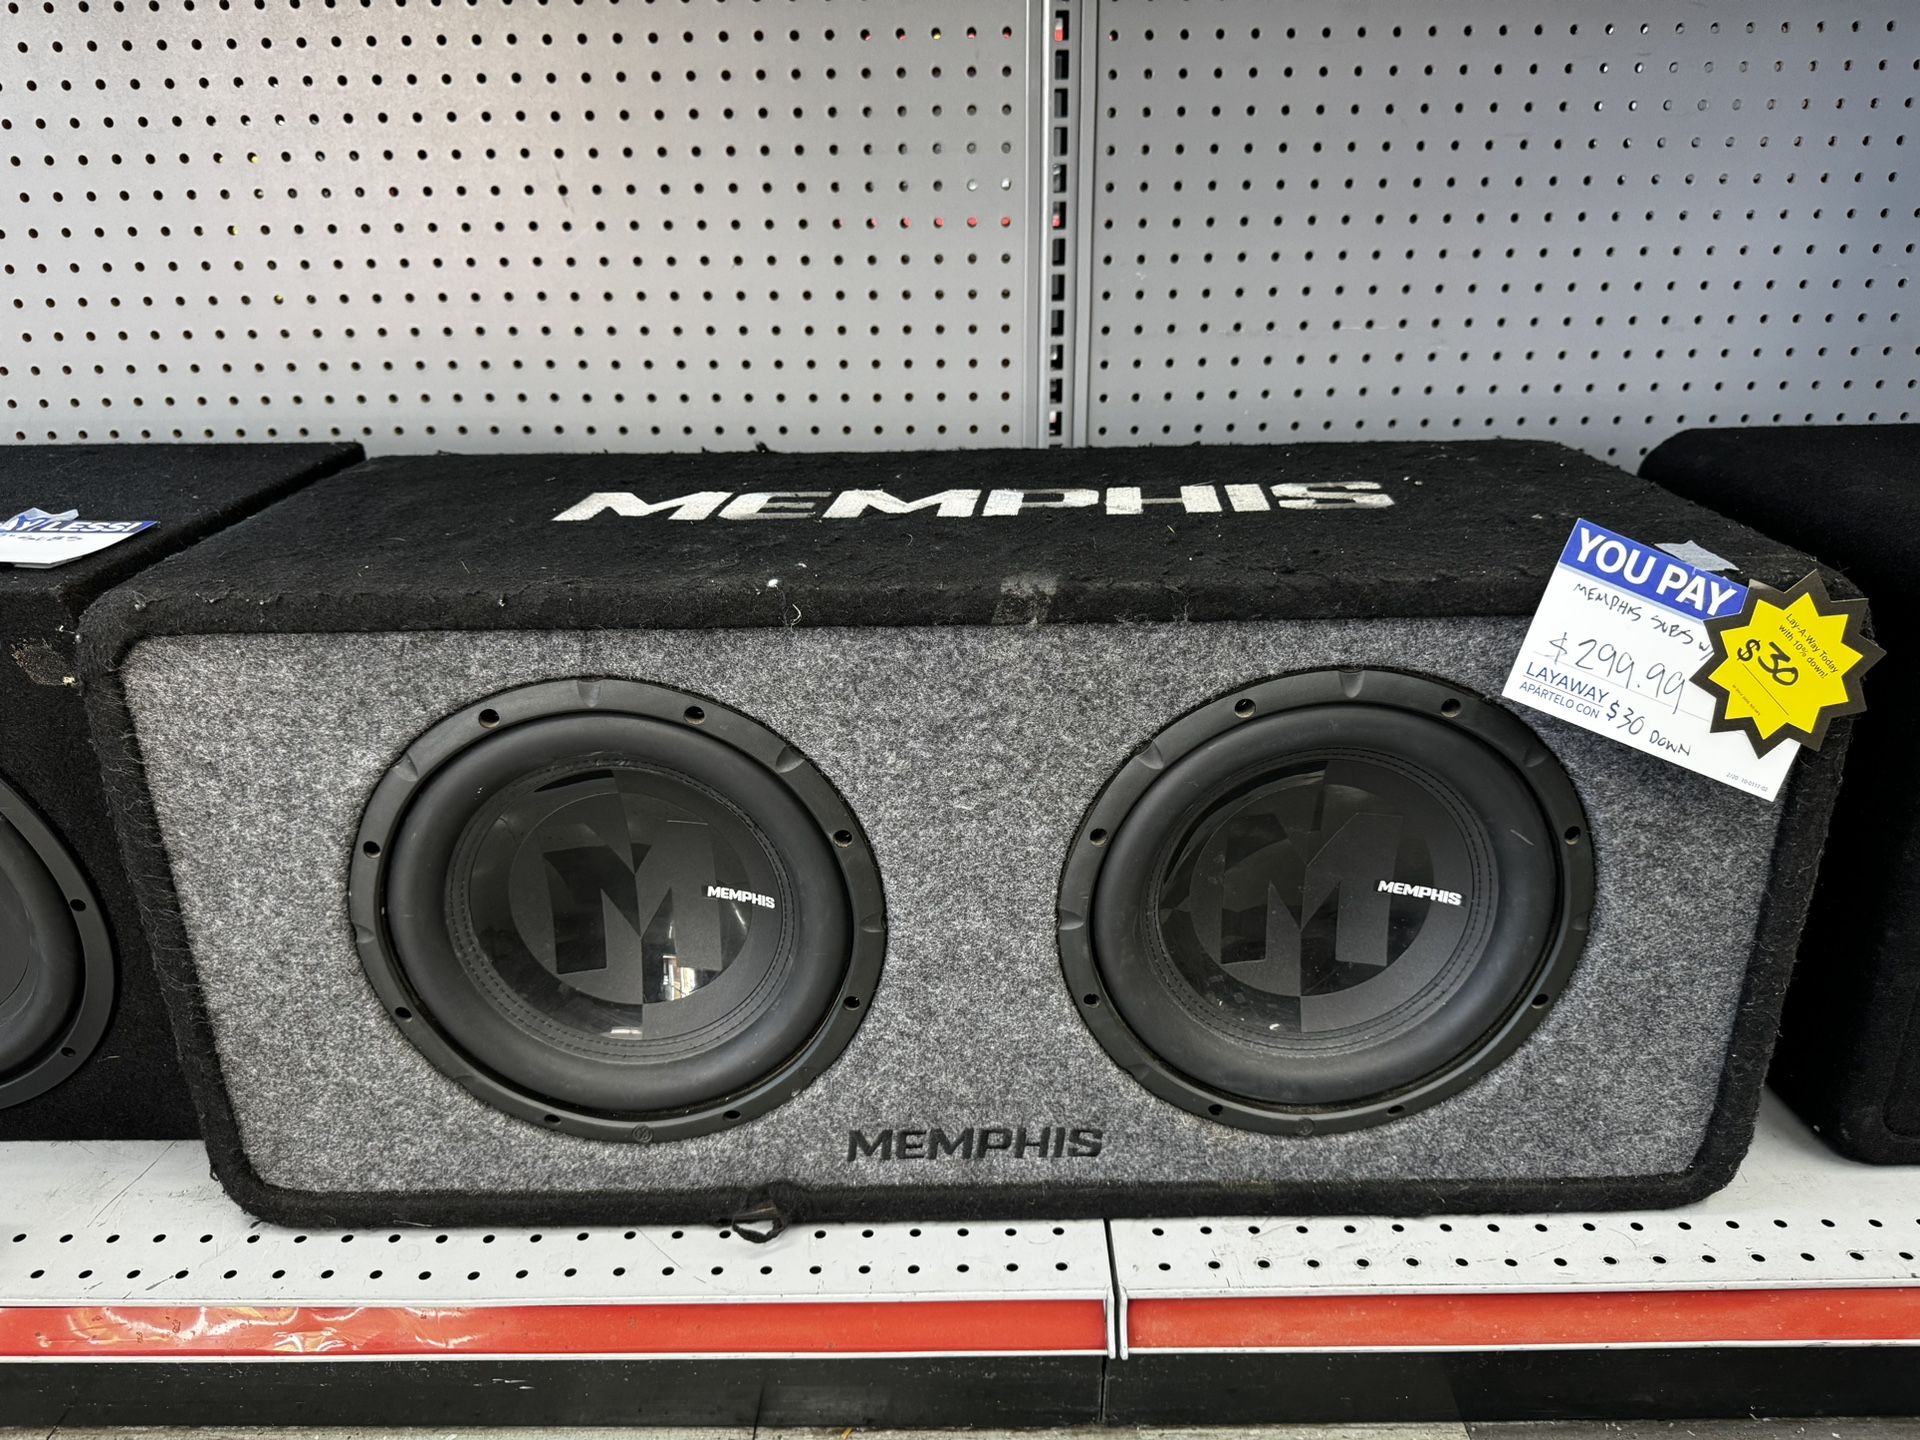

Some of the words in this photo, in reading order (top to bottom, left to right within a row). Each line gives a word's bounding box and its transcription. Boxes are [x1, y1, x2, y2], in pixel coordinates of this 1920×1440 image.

[552, 481, 1396, 522] MEMPHIS
[1577, 527, 1656, 585] YOU
[1656, 563, 1738, 617] PAY
[1573, 583, 1642, 622] MEMPHIS
[1651, 614, 1694, 645] SUBS
[1778, 624, 1794, 643] with
[1792, 640, 1808, 659] 10%
[1806, 657, 1829, 679] down!
[1786, 613, 1820, 657] Lay-A-Way
[1818, 651, 1838, 674] Today
[1519, 679, 1575, 709] APÁRTELO
[1575, 702, 1600, 719] CON
[1526, 661, 1610, 703] LAYAWAY
[1649, 730, 1691, 757] DOWN
[707, 885, 776, 909] MEMPHIS
[1377, 880, 1463, 906] MEMPHIS
[847, 1127, 1104, 1162] MEMPHIS
